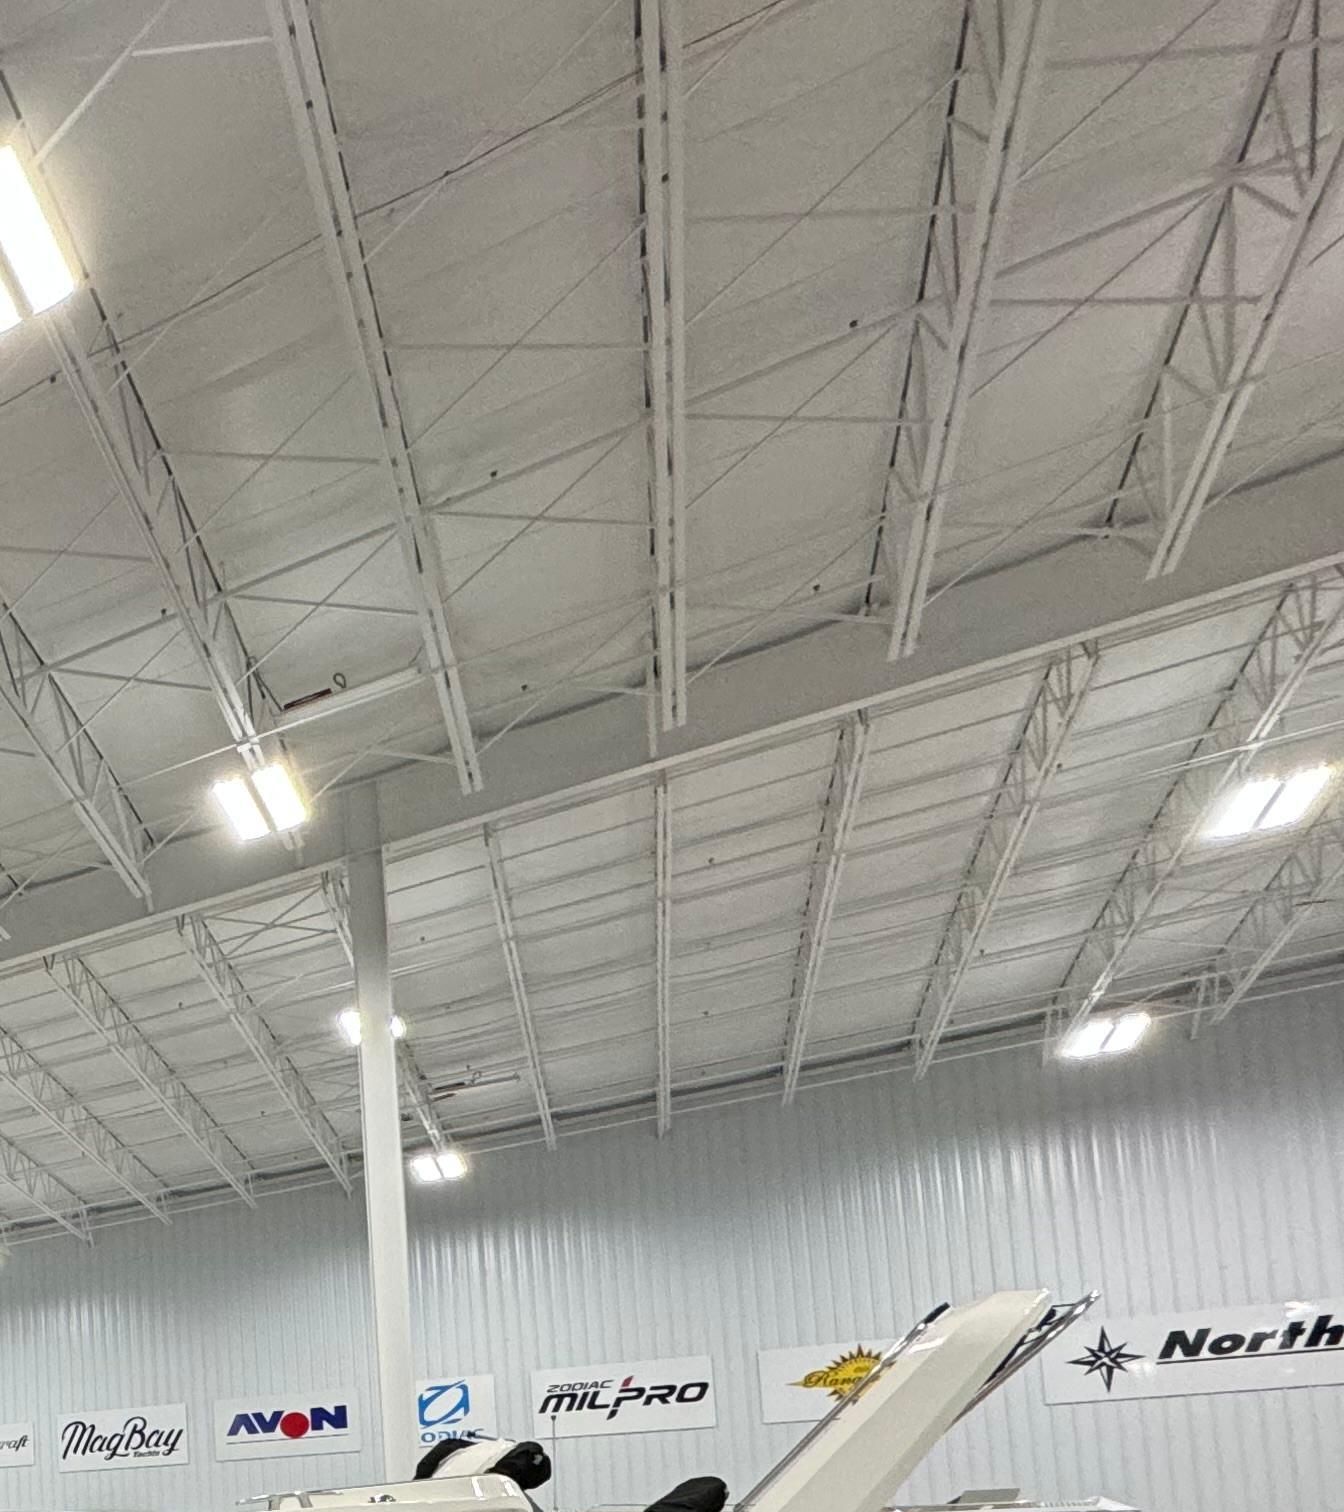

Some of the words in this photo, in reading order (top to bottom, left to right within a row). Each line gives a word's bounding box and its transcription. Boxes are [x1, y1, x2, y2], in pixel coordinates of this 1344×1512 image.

[1158, 1314, 1344, 1359] North
[538, 1375, 709, 1421] MILPRO
[546, 1379, 615, 1393] ZODIAC
[61, 1416, 184, 1461] MagBay
[227, 1405, 348, 1439] AVON
